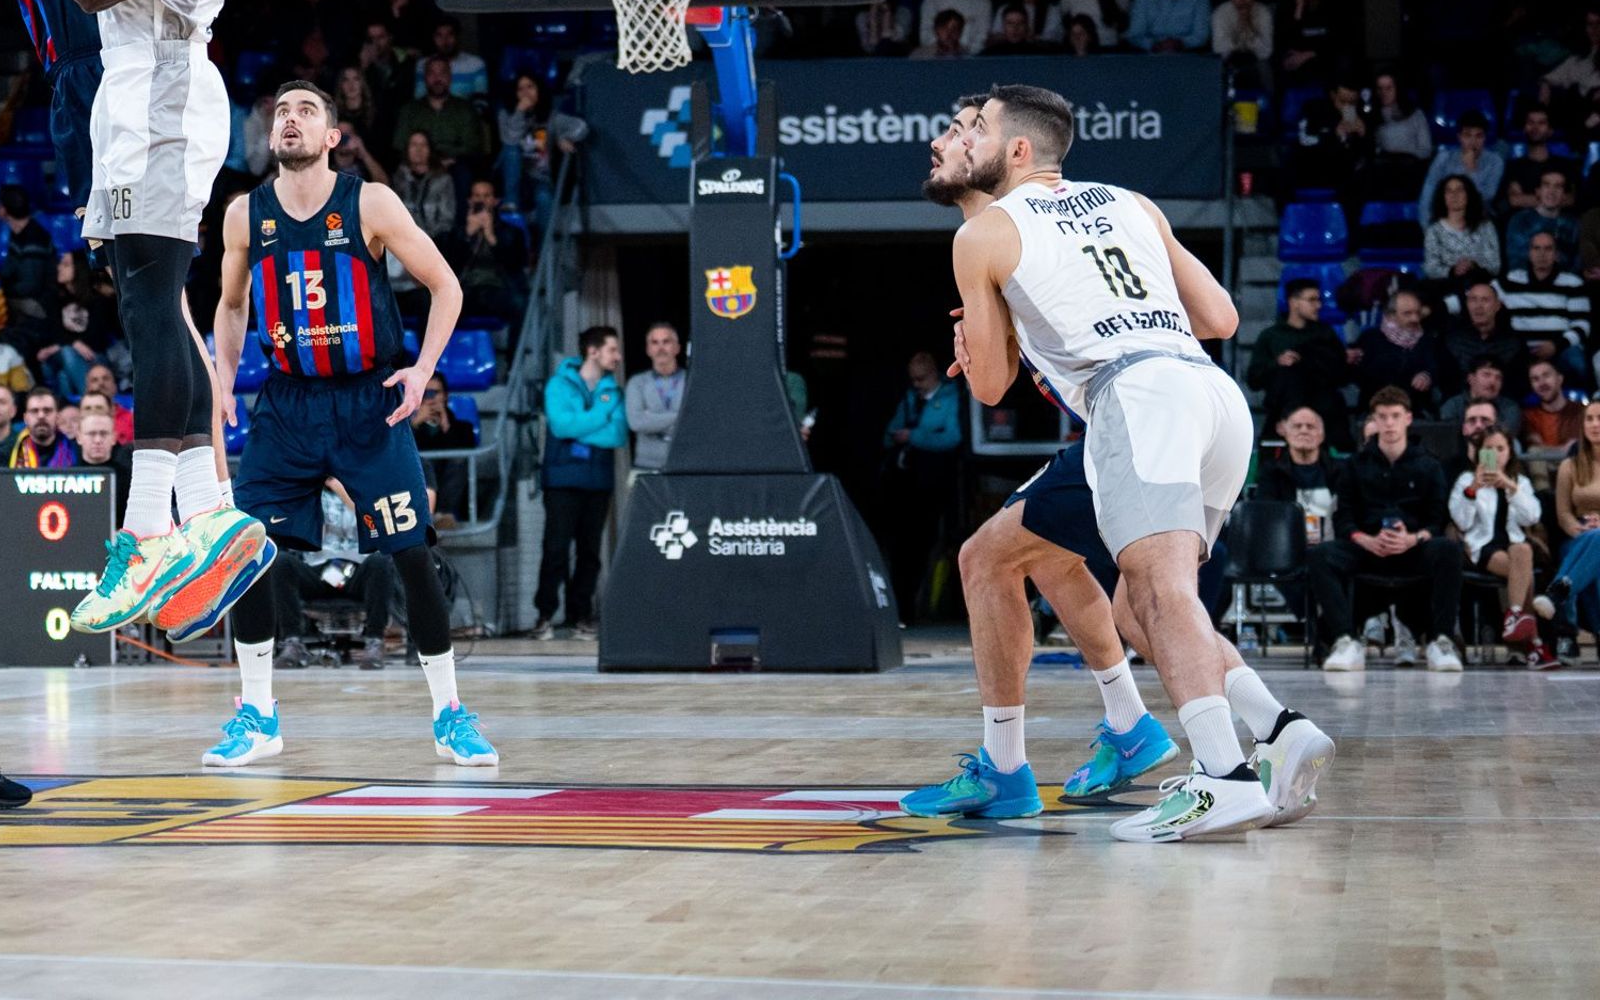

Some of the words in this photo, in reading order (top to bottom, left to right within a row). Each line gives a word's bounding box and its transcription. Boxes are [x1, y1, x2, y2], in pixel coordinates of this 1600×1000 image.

[778, 104, 956, 145] ssistènc
[1066, 101, 1162, 140] tària
[698, 178, 765, 196] SPALDING
[111, 187, 132, 220] 26
[1082, 245, 1148, 301] 10
[285, 269, 327, 311] 13
[297, 321, 359, 336] Assistència
[298, 335, 341, 347] Sanitària
[14, 475, 105, 495] VISITANT
[37, 500, 70, 542] 0
[373, 490, 418, 536] 13
[708, 516, 818, 537] Assistència
[708, 536, 786, 556] Sanitària
[29, 571, 97, 591] FALTES
[45, 607, 71, 641] 0
